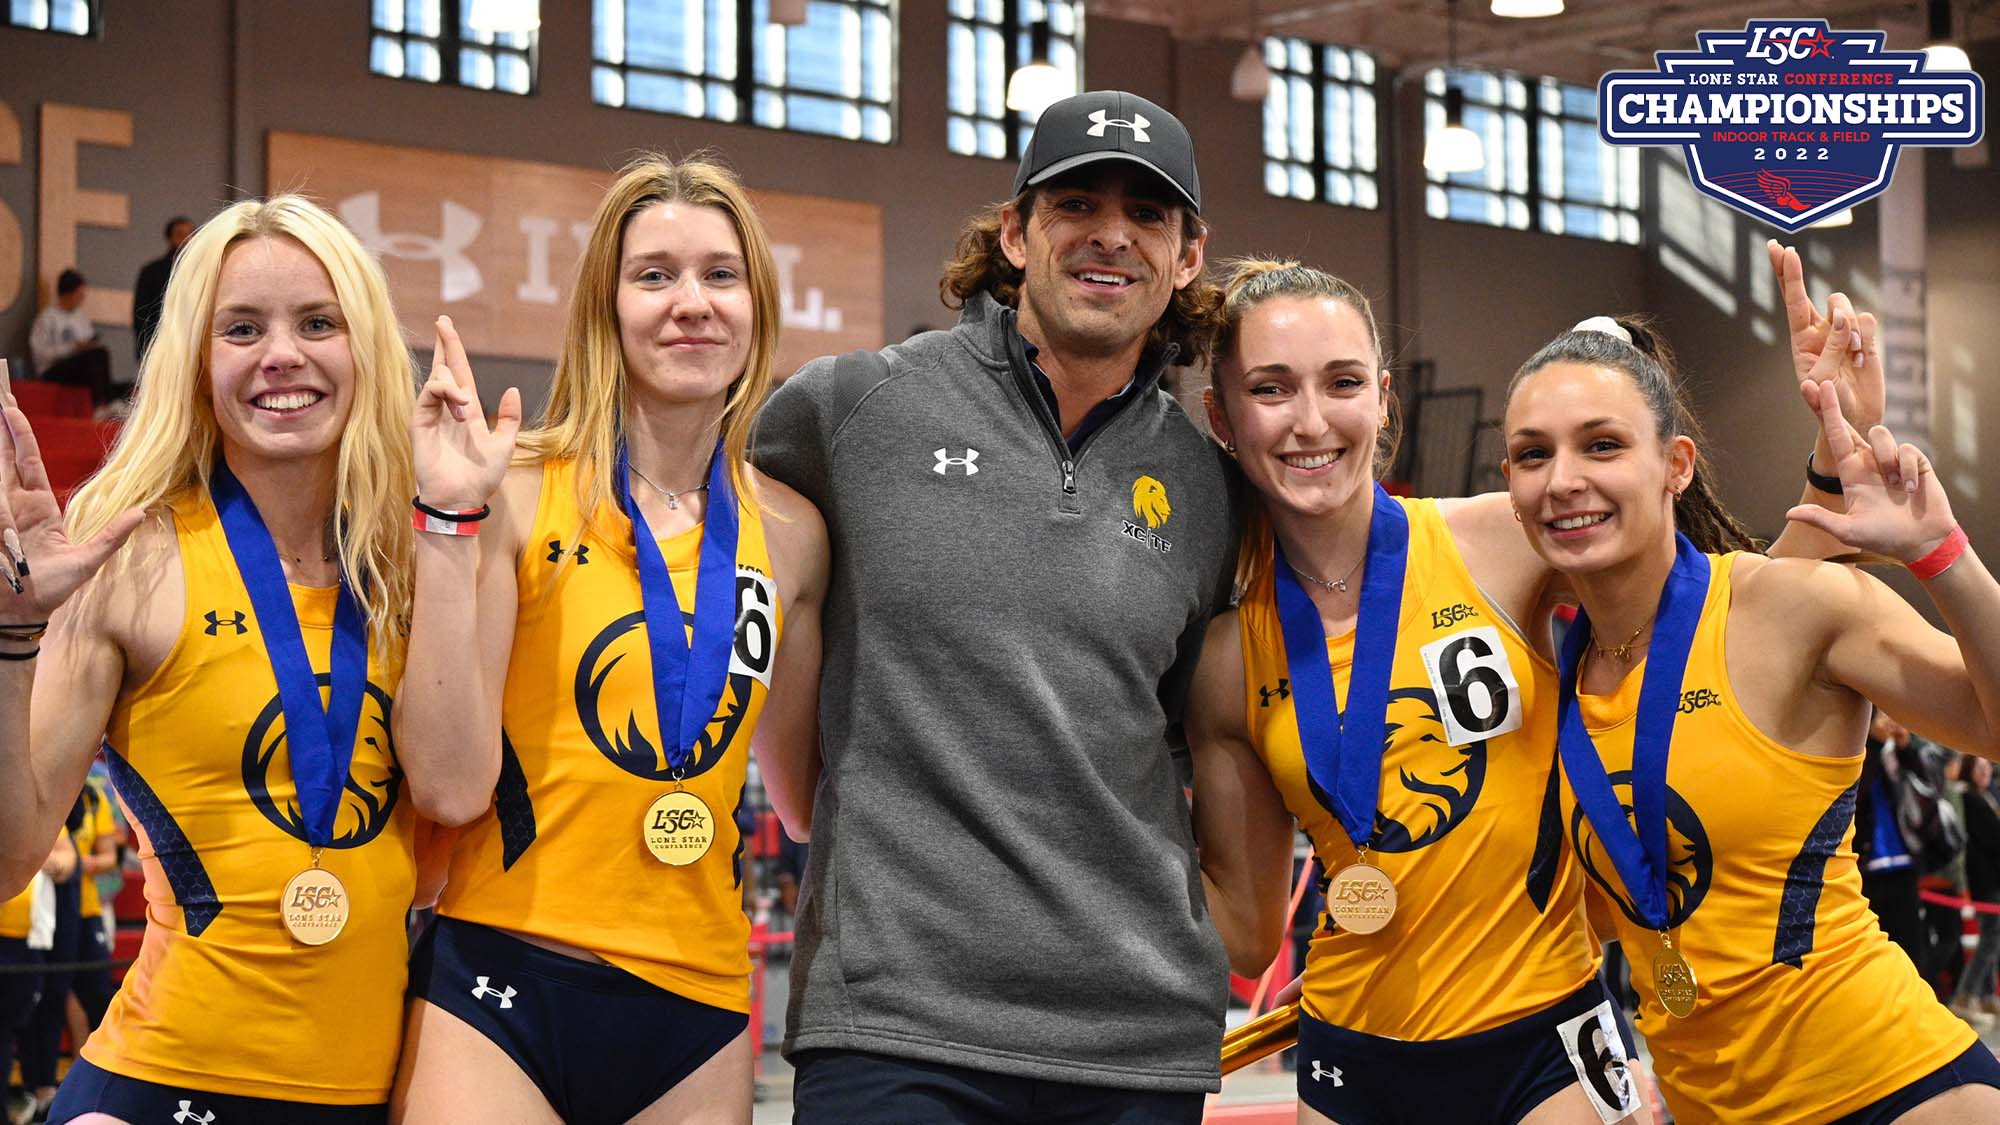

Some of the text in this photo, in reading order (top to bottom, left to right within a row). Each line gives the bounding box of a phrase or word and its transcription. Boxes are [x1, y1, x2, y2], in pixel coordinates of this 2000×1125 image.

[734, 575, 772, 674] 6
[1431, 603, 1464, 630] LSC
[1438, 635, 1510, 733] 6
[651, 808, 695, 834] LSC
[650, 835, 708, 844] LONE STAR
[291, 886, 332, 912] LSC
